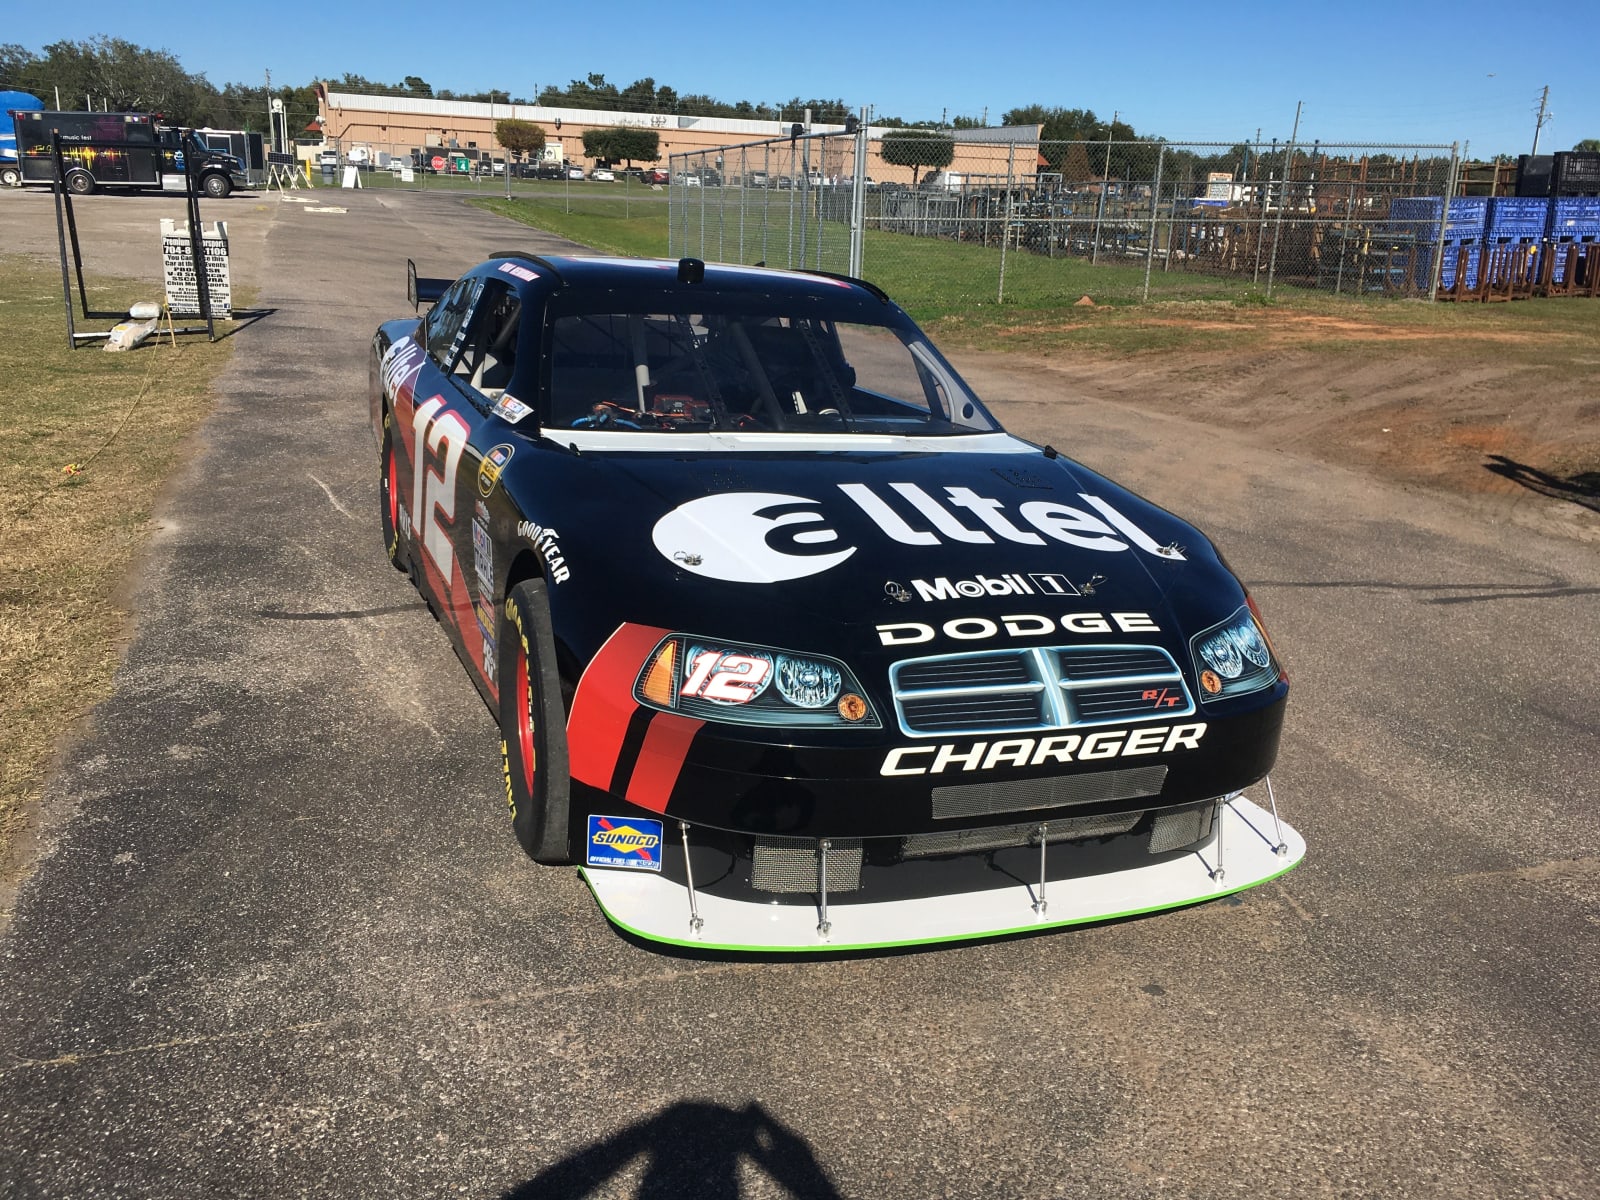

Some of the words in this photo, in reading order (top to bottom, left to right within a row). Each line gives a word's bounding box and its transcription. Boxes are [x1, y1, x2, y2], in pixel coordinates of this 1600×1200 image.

[164, 246, 227, 256] 704-8-1106
[412, 393, 472, 592] 12
[517, 520, 571, 585] GOODYEAR
[910, 573, 1035, 602] Mobil
[875, 612, 1161, 646] DODGE
[679, 650, 771, 704] 12
[1141, 688, 1180, 709] R/T
[880, 722, 1208, 777] CHARGER
[595, 832, 657, 847] SUNOCO
